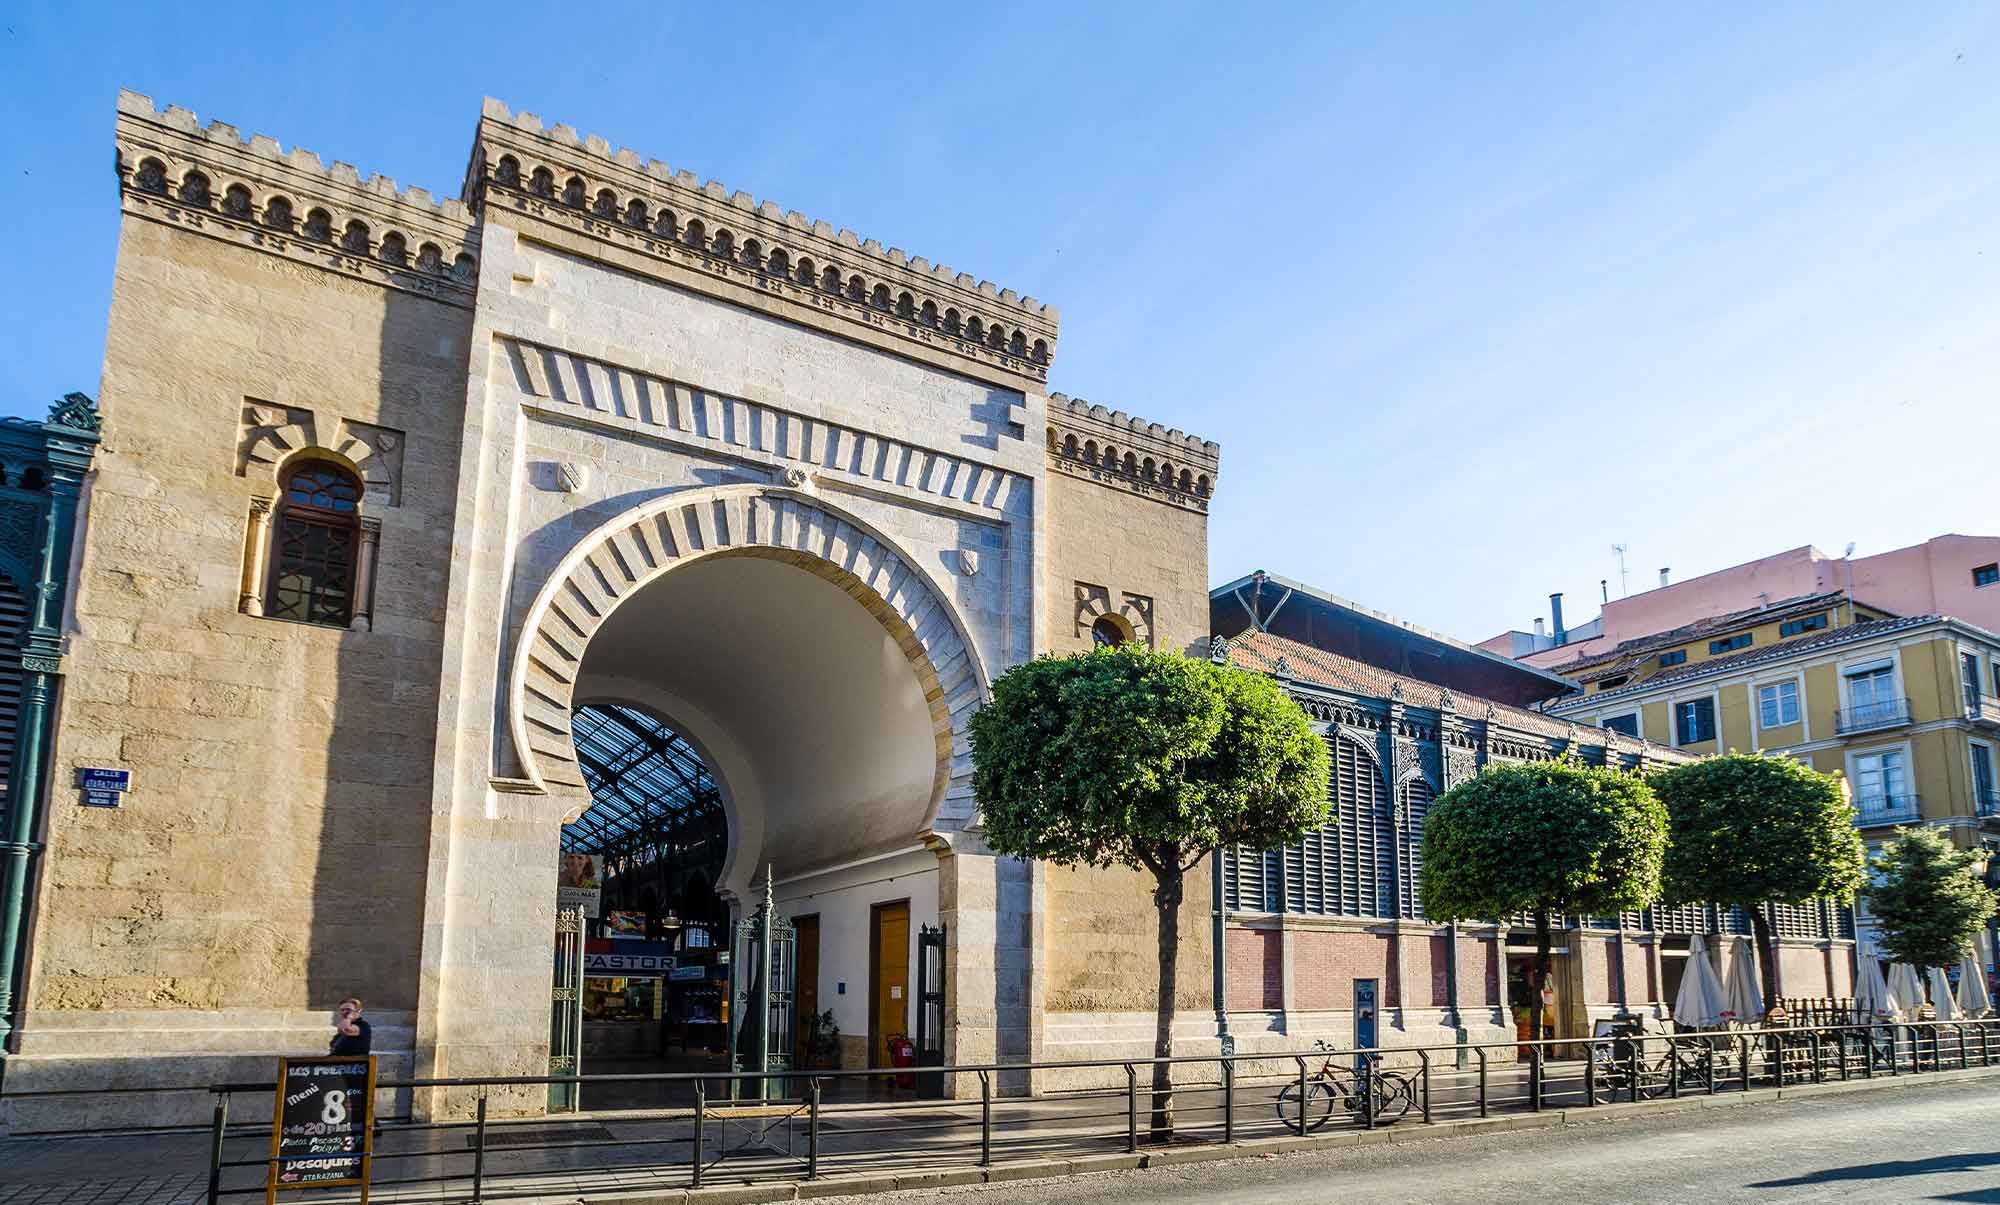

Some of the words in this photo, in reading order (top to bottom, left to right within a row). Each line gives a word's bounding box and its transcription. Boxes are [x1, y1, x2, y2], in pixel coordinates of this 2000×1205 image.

[584, 956, 673, 968] PASTOR
[321, 1089, 346, 1124] 8
[304, 1122, 326, 1135] 20
